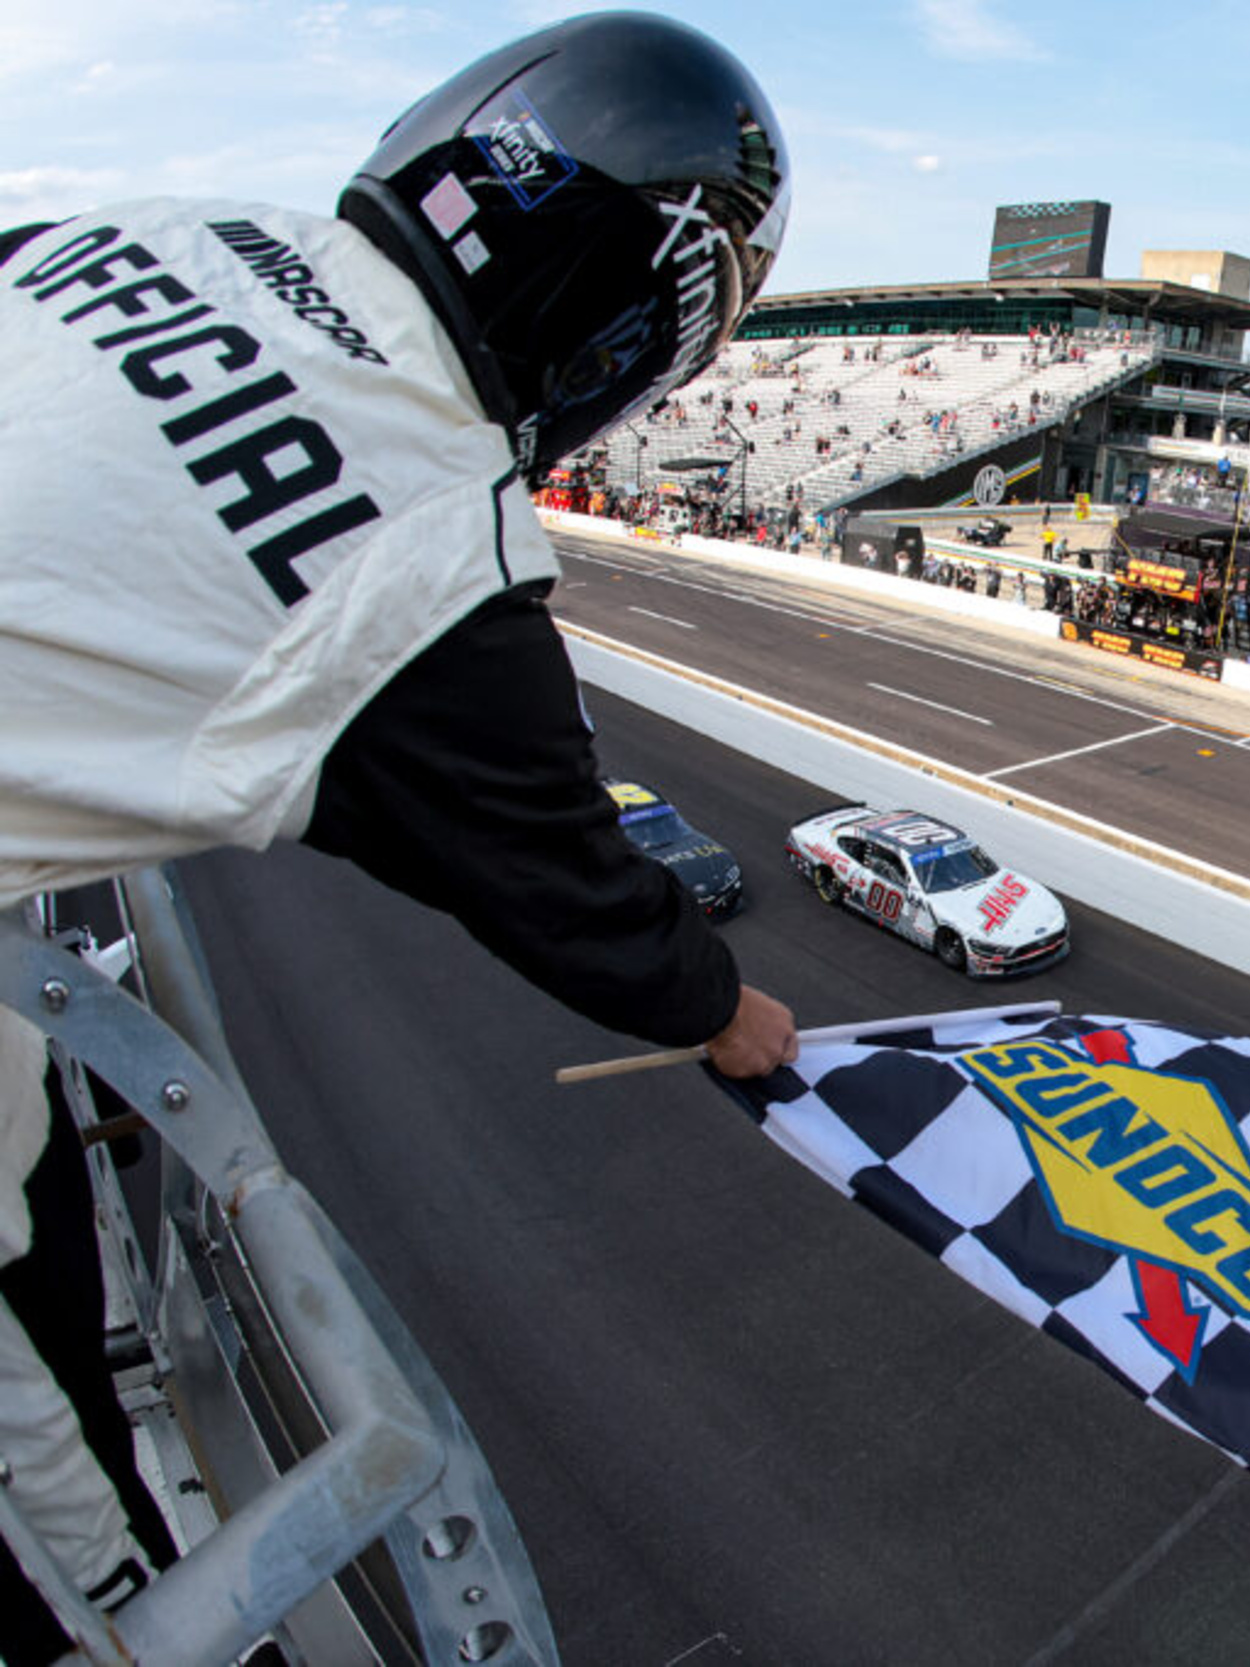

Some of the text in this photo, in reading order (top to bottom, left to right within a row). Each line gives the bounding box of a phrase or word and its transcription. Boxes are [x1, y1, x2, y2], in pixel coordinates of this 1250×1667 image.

[232, 240, 390, 367] NASCAR
[13, 224, 383, 609] OFFICIAL
[866, 880, 904, 920] 00
